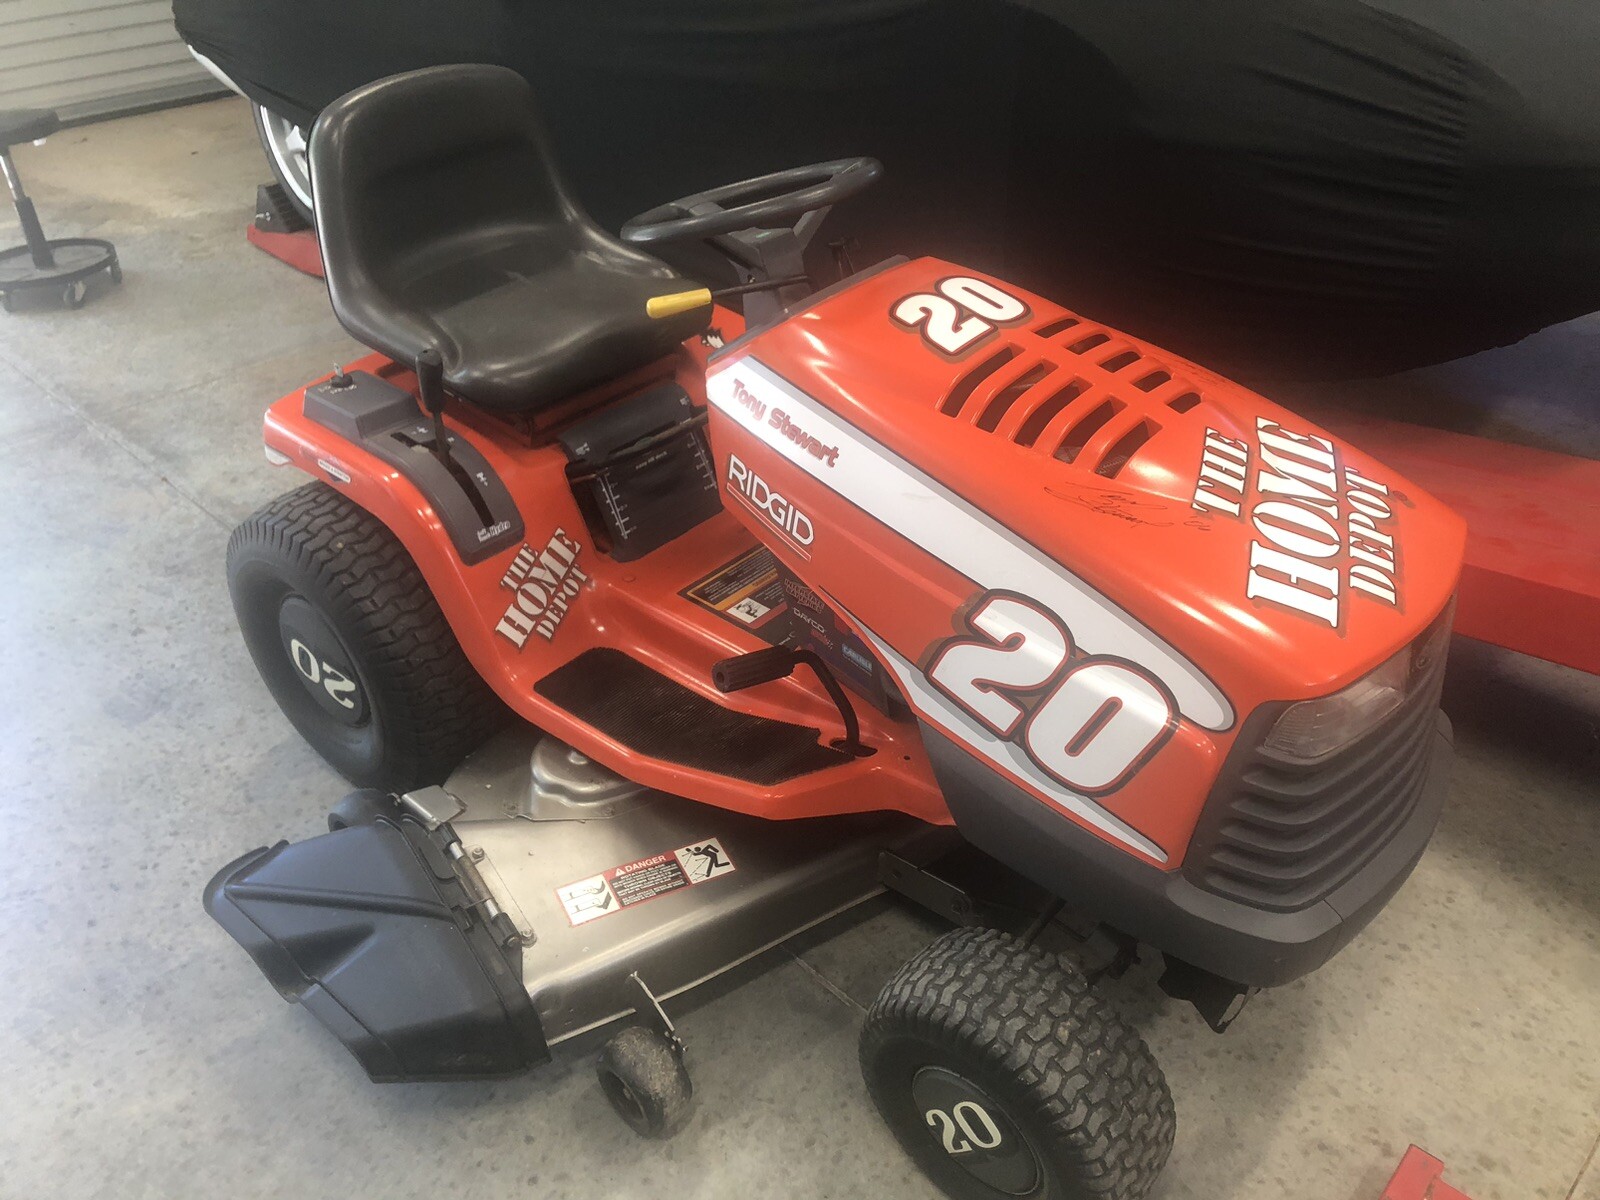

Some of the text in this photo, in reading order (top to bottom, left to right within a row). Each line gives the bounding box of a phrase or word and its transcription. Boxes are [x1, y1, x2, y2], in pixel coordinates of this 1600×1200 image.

[890, 276, 1030, 356] 20
[732, 378, 839, 468] Tony Stewart
[728, 453, 814, 545] RIDGID
[1191, 426, 1249, 518] THE
[1247, 415, 1342, 629] HOME
[1345, 465, 1397, 605] DEPOT
[495, 527, 581, 649] HOME
[500, 542, 539, 591] THE
[536, 563, 588, 640] DEPOT
[793, 607, 825, 634] DAYCO
[290, 638, 356, 709] 20
[925, 589, 1180, 796] 20
[625, 855, 667, 872] DANGER
[925, 1101, 1002, 1154] 20
